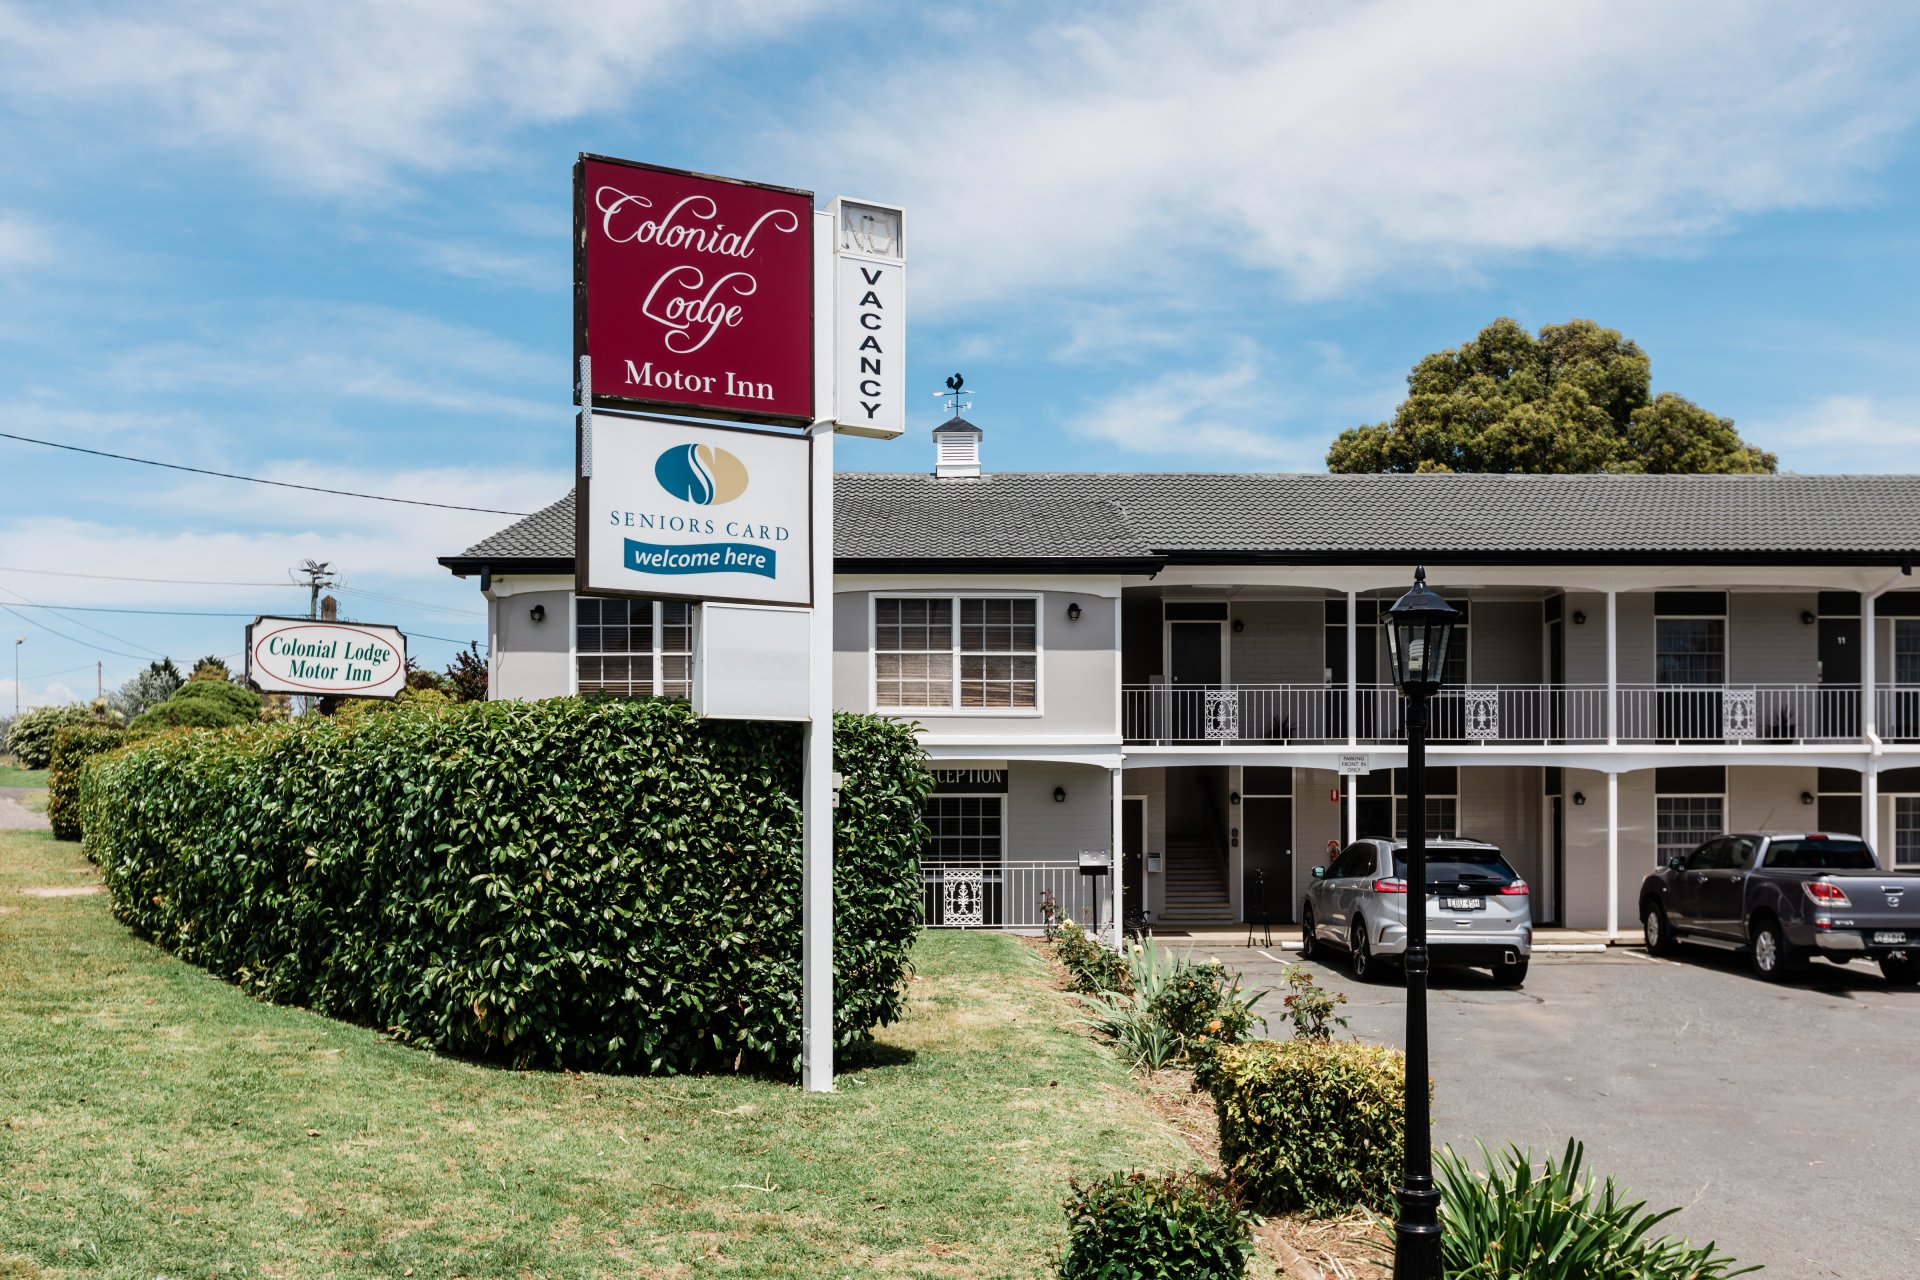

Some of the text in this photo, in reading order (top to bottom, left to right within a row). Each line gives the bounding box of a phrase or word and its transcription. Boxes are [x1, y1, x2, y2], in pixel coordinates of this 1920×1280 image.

[596, 186, 798, 259] Colonial
[642, 265, 757, 354] Lodge
[859, 267, 883, 419] VACANCY
[624, 360, 775, 401] Motor Inn
[610, 510, 789, 541] SENIORS CARD
[635, 547, 766, 569] welcome here
[269, 636, 390, 666] Colonial Lodge
[288, 660, 372, 682] Motor Inn
